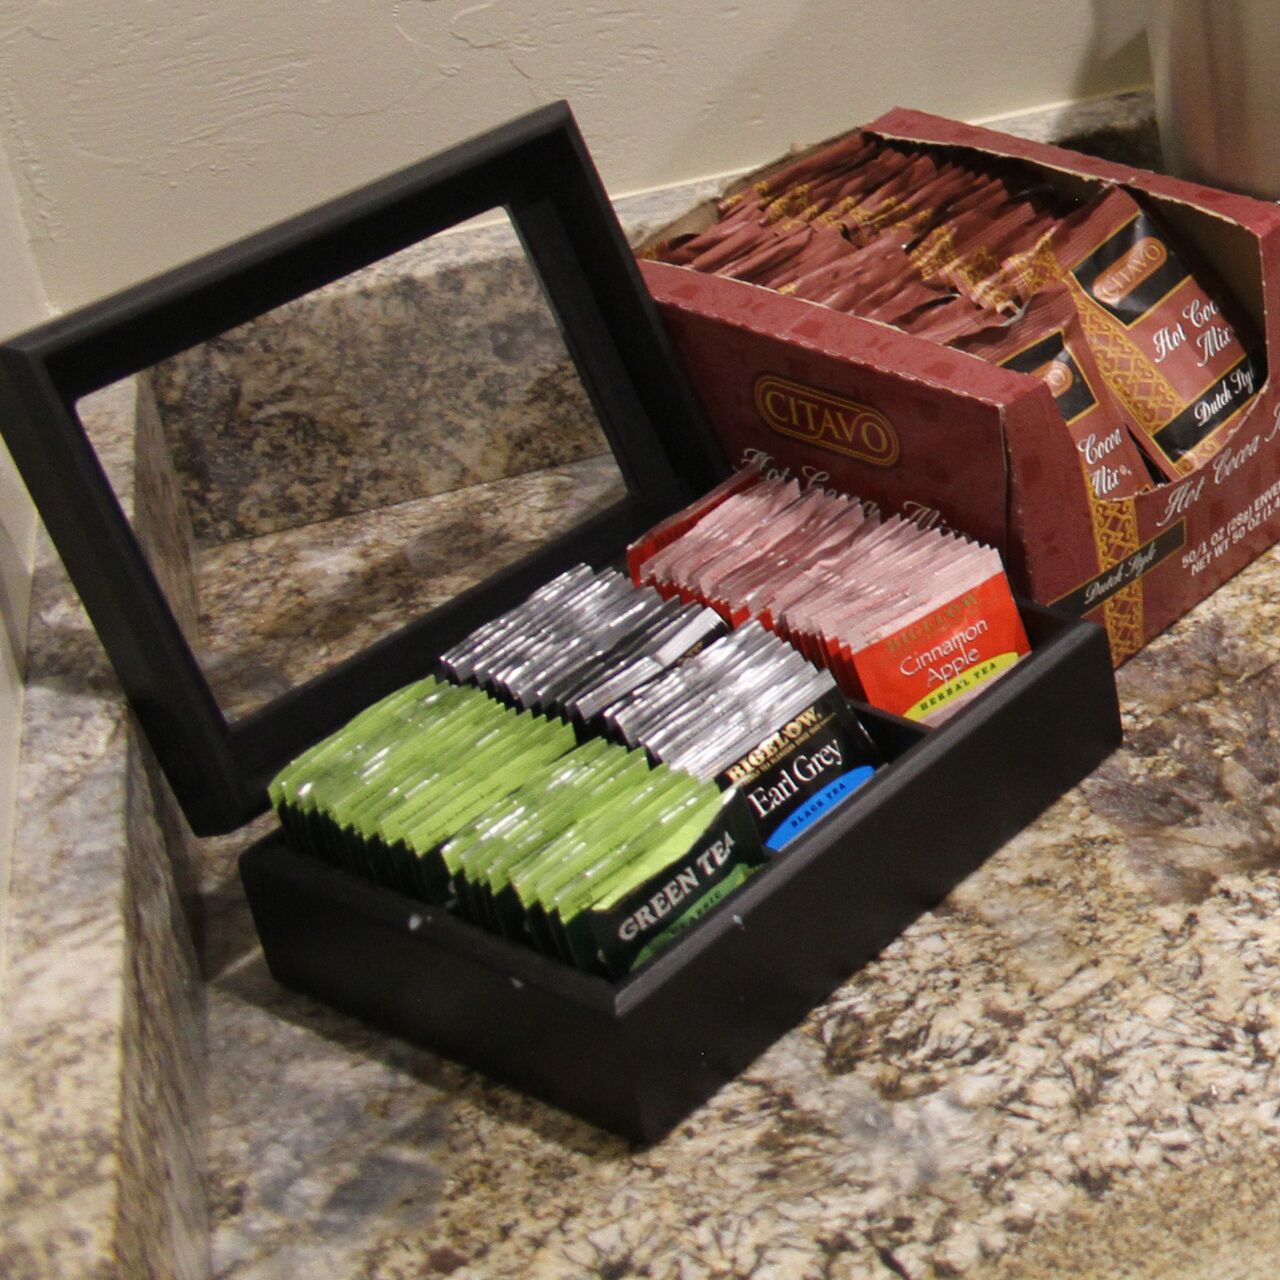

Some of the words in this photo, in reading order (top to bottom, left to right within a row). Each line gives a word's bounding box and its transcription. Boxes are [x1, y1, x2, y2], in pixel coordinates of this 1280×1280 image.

[1102, 243, 1162, 298] CITAVO
[1153, 322, 1187, 363] Hot
[1196, 326, 1233, 367] Mix
[765, 391, 888, 453] CITAVO
[1194, 379, 1234, 427] Dutch
[1077, 428, 1123, 465] Cocoa
[1156, 477, 1206, 527] Hot
[1213, 434, 1261, 484] Cocoa
[1182, 540, 1208, 568] 50/1
[1211, 526, 1226, 545] OZ
[1191, 551, 1212, 576] NET
[1215, 540, 1230, 559] WT
[1232, 527, 1246, 544] 50
[1248, 515, 1262, 534] OZ
[1084, 563, 1124, 605] Dutch
[1125, 542, 1157, 577] Style
[900, 619, 989, 677] Cinnamon
[926, 641, 981, 688] Apple
[920, 677, 971, 711] HERBAL
[974, 662, 998, 679] TEA
[725, 706, 820, 785] BIGELOW
[747, 769, 800, 818] Earl
[793, 738, 844, 782] Grey
[791, 799, 825, 828] BLACK
[828, 782, 846, 800] TEA
[618, 866, 700, 941] GREEN
[696, 830, 736, 876] TEA
